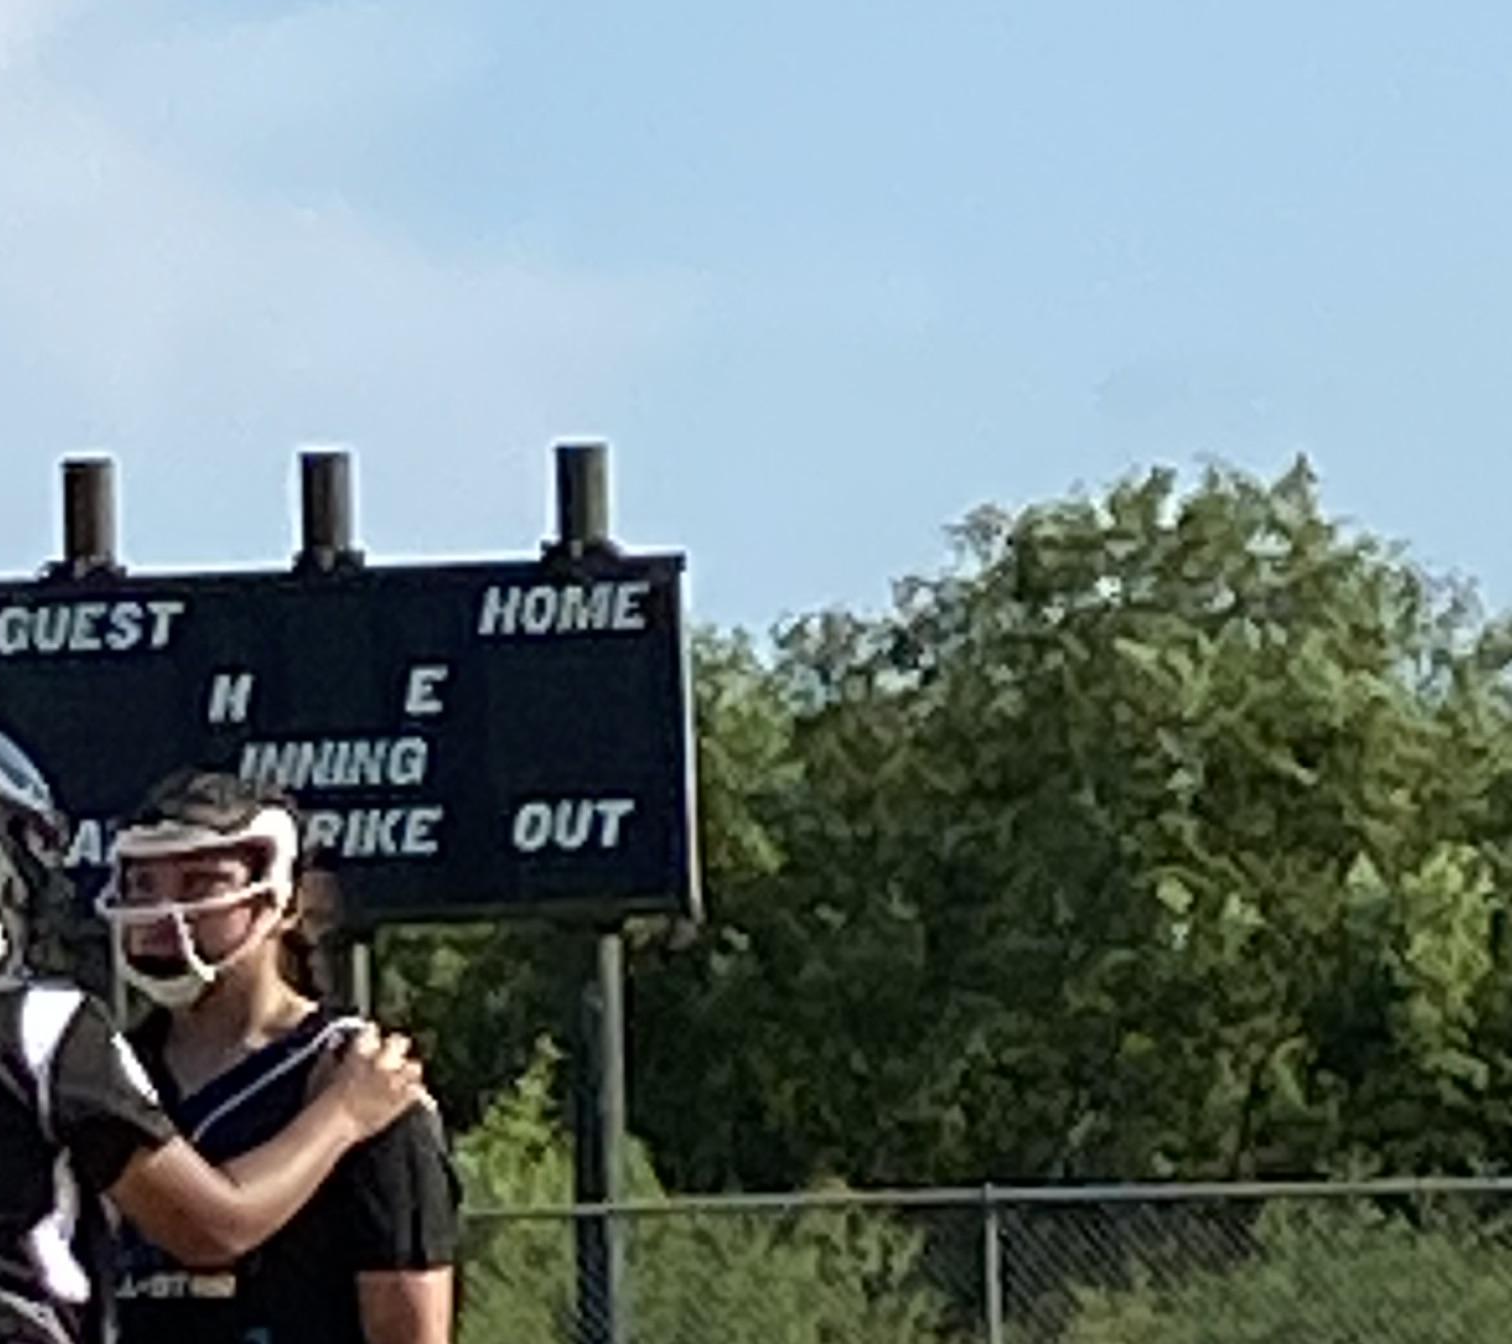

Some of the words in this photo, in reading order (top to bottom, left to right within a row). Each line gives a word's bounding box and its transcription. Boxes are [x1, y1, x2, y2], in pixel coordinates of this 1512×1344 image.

[477, 581, 650, 635] HOME
[209, 673, 254, 723] H
[405, 665, 449, 716] E
[239, 736, 428, 790] INNING
[302, 805, 442, 858] RIKE
[512, 798, 635, 851] OUT
